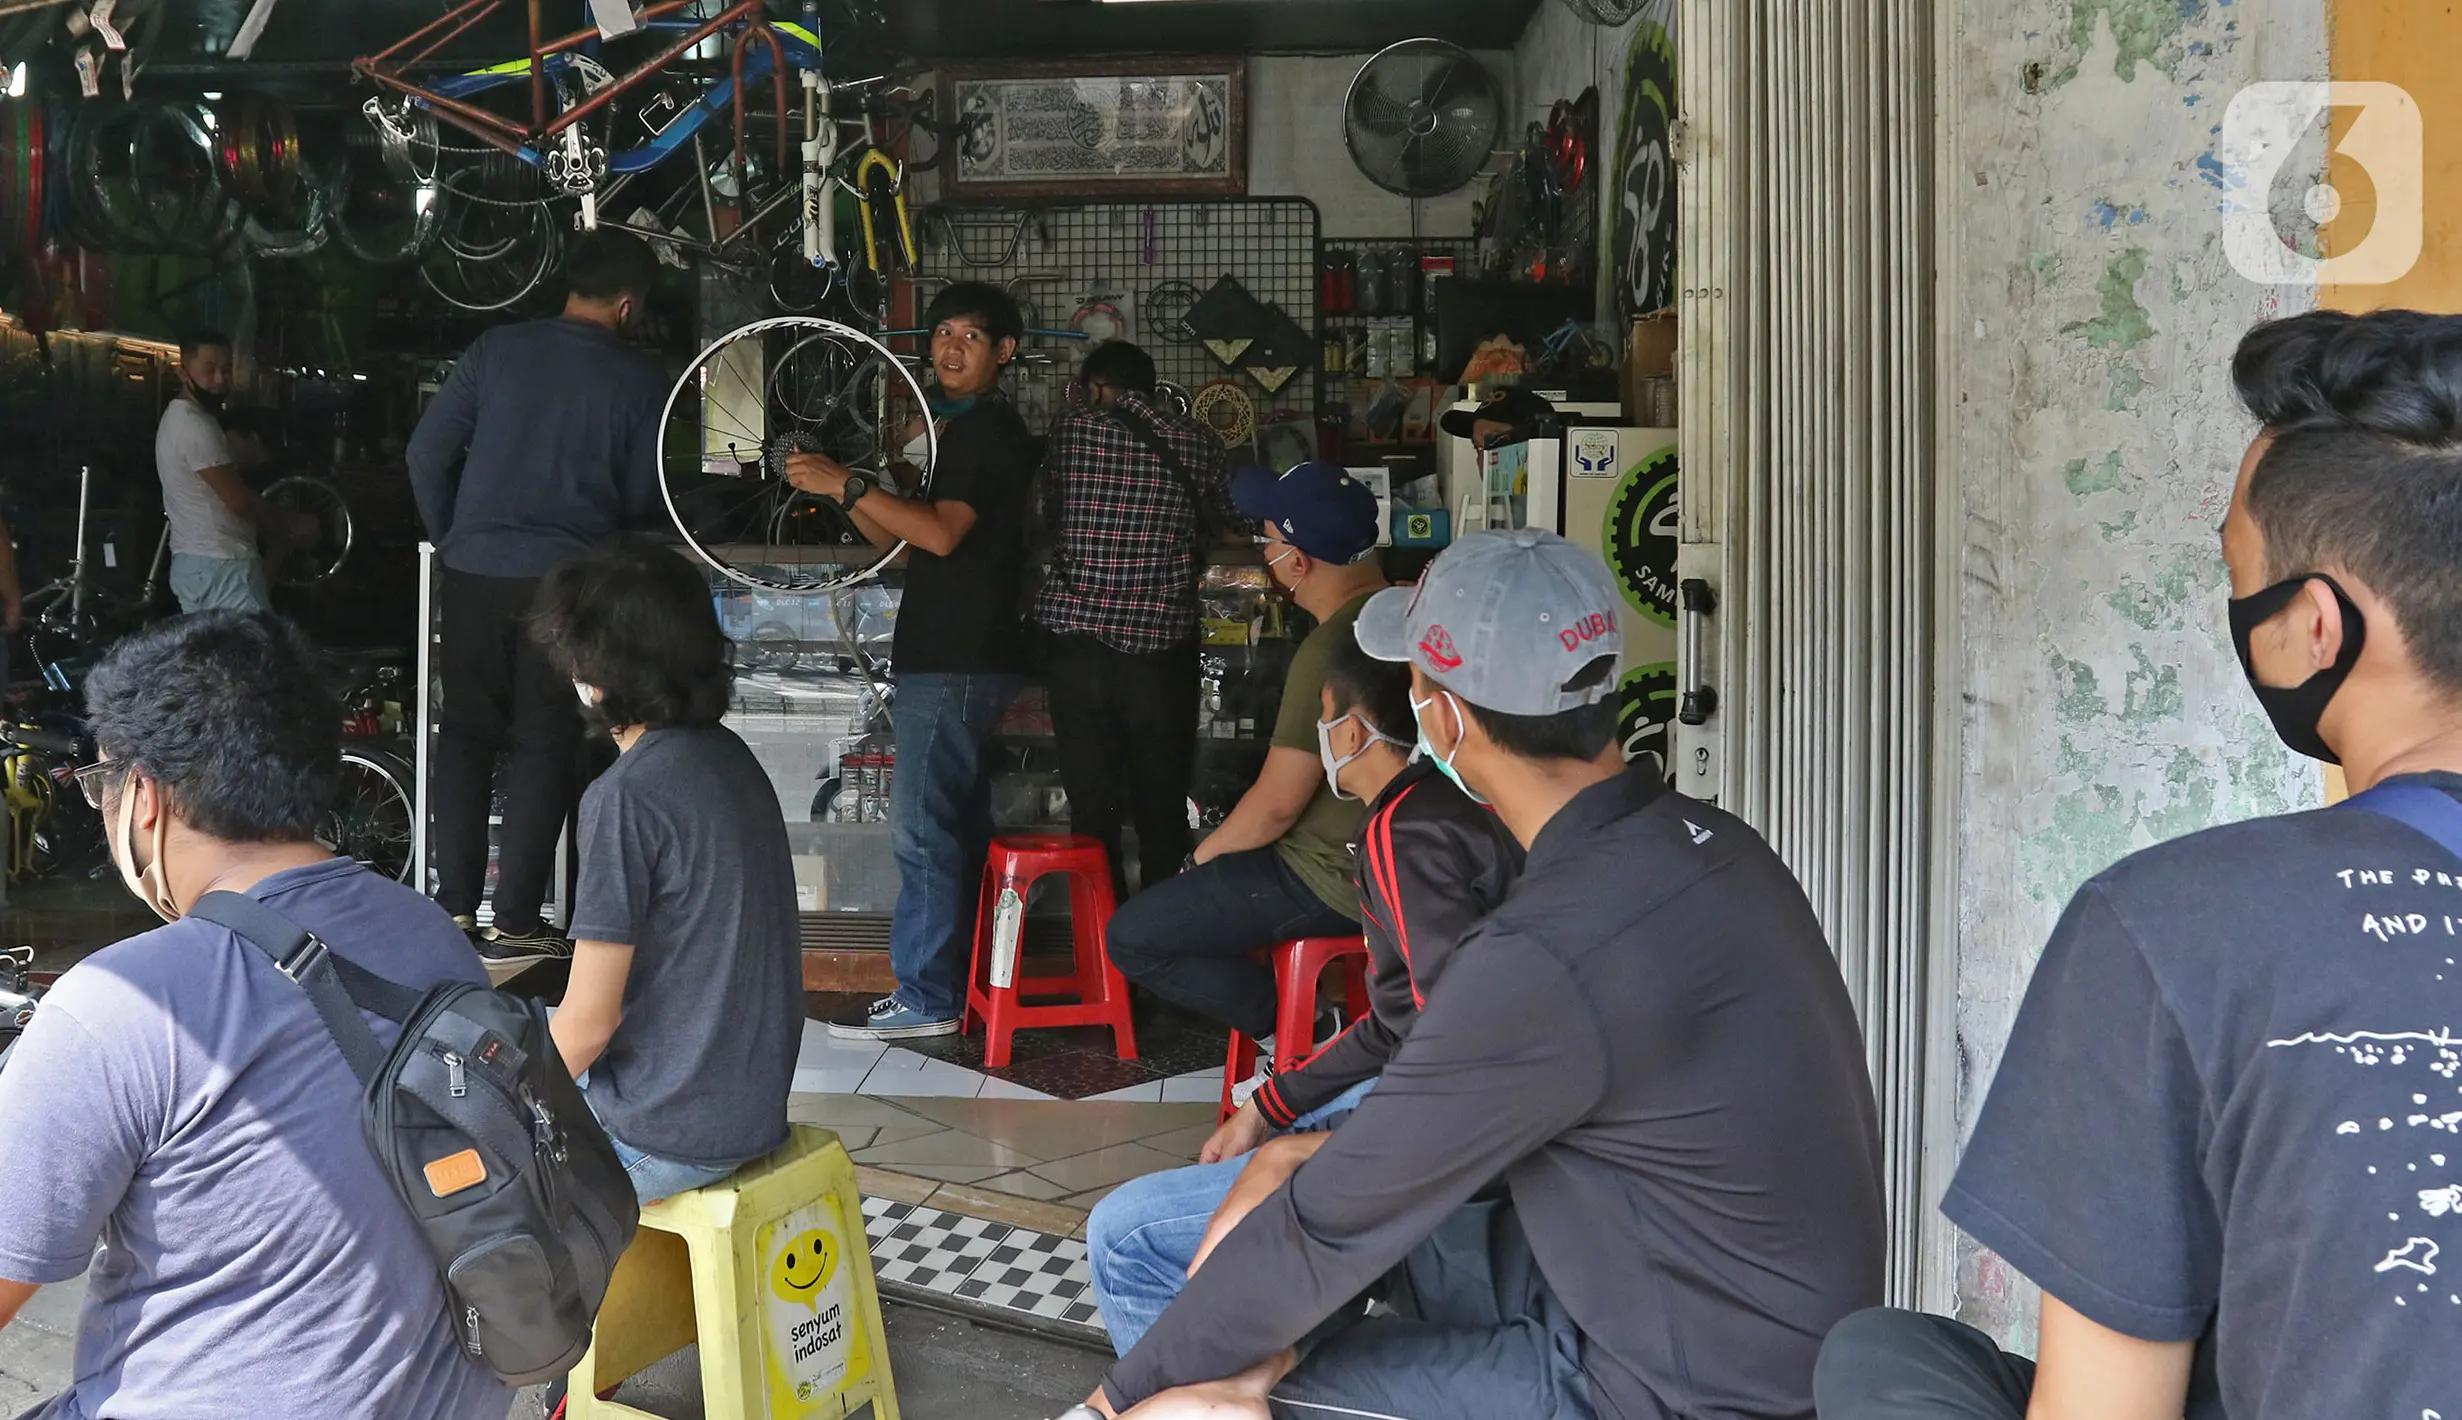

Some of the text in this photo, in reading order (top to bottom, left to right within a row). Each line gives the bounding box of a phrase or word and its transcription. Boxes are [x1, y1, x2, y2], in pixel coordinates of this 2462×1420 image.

[1635, 565, 1677, 605] SAM
[2336, 868, 2394, 888] THE
[2362, 913, 2462, 943] AND I
[791, 1304, 840, 1342] senyum
[794, 1321, 841, 1363] indosat
